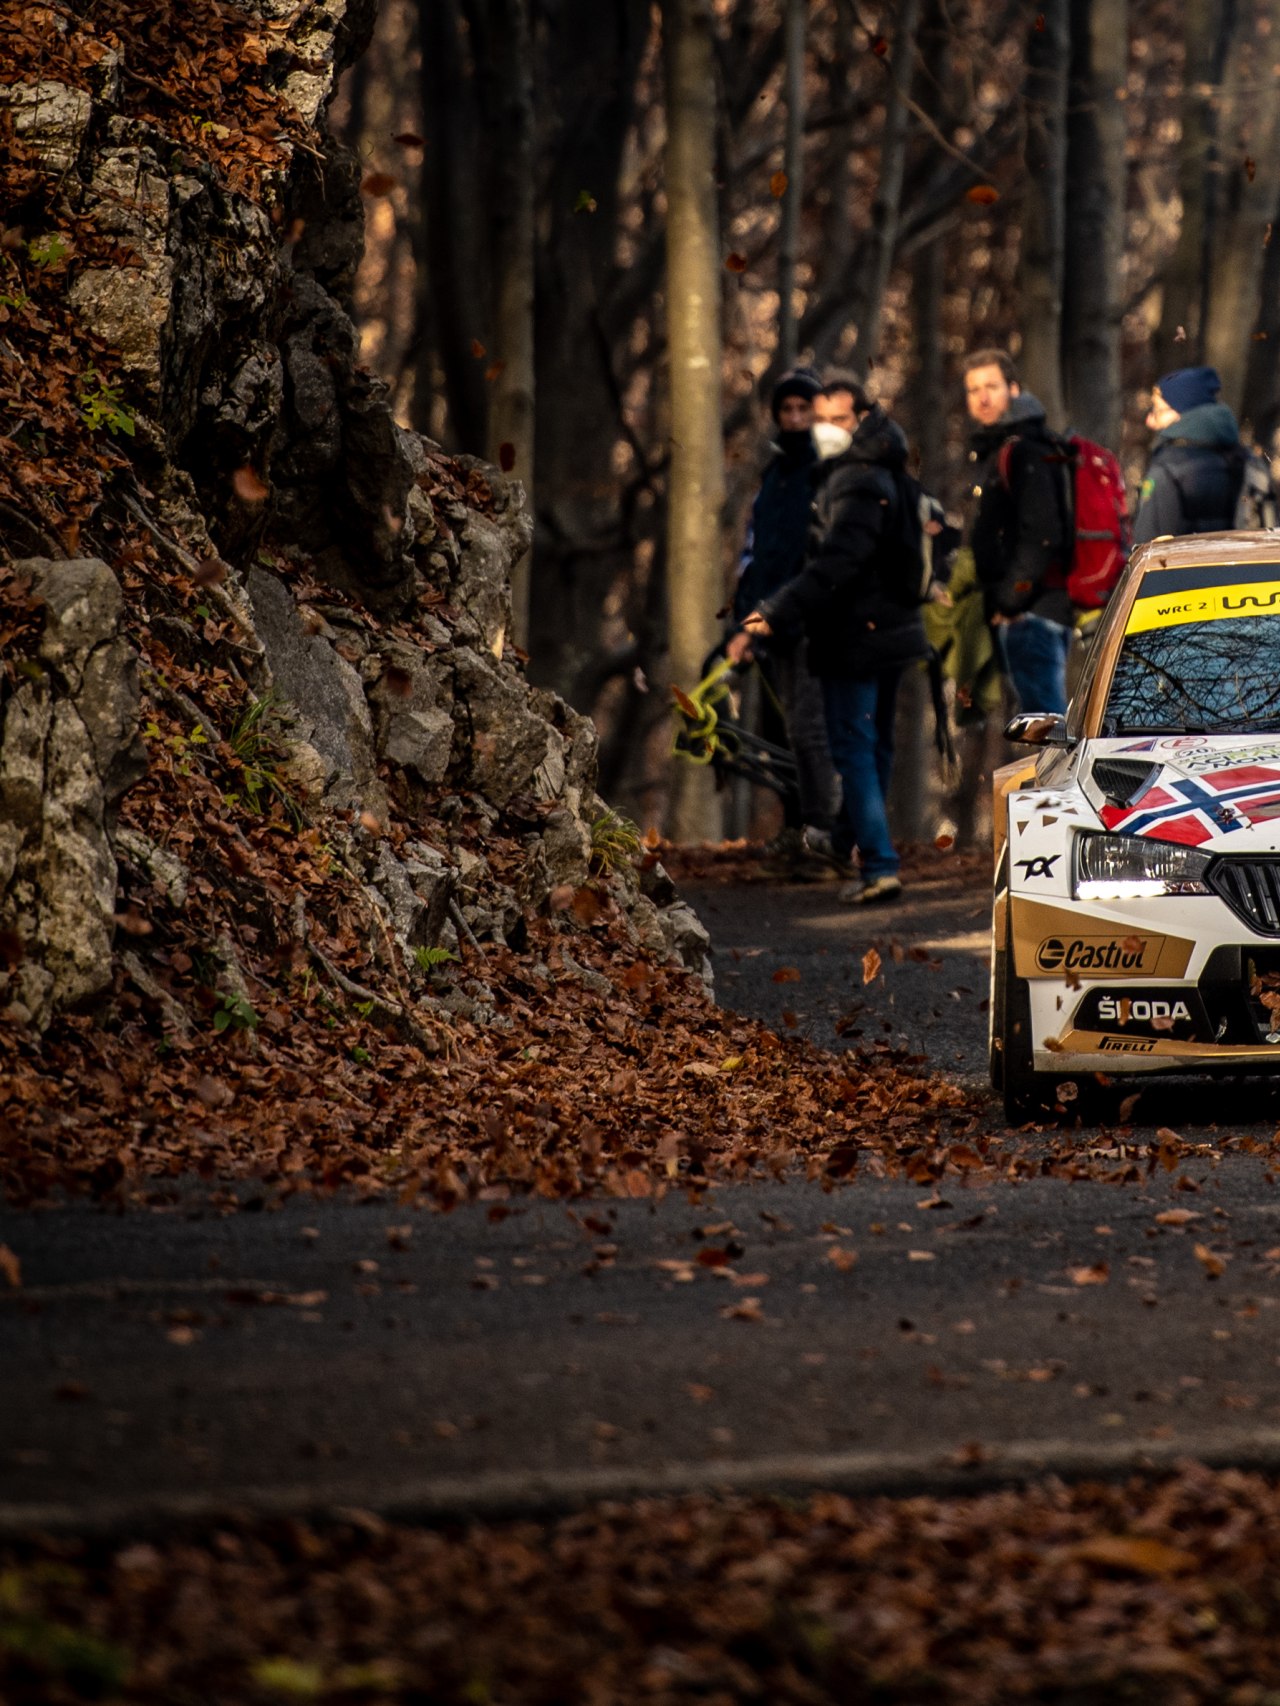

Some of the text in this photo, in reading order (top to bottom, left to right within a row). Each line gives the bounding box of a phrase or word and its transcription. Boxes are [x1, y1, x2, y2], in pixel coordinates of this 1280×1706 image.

[1157, 602, 1207, 616] WRC 2
[1097, 1036, 1159, 1052] PIRELLI
